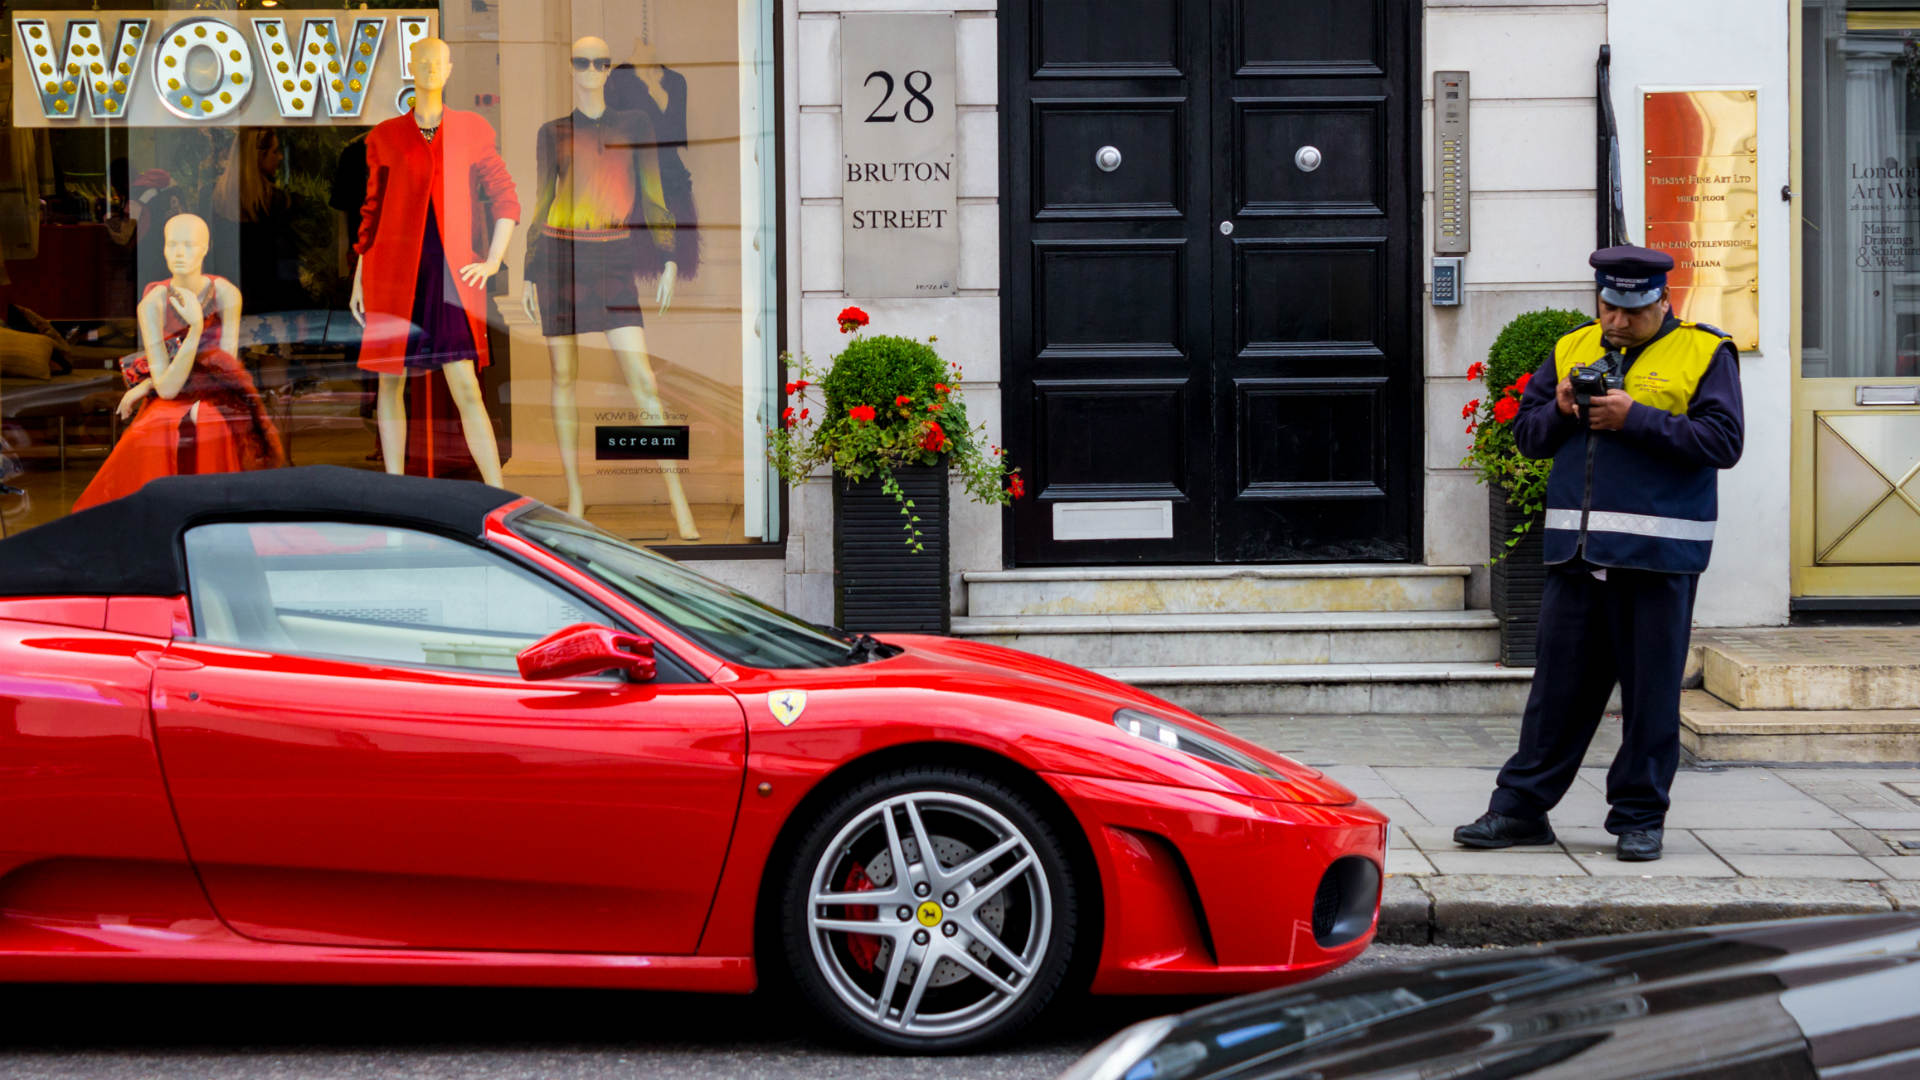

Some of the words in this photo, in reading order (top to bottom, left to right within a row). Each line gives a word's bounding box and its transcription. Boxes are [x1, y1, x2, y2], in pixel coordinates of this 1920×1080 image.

[863, 70, 934, 123] 28
[847, 162, 951, 182] BRUTON
[1852, 183, 1884, 199] Art
[852, 210, 947, 229] STREET
[1864, 223, 1901, 234] Master
[1864, 235, 1914, 247] Drawings
[1681, 259, 1721, 269] ITALIANA
[1856, 246, 1872, 268] &
[1876, 256, 1904, 267] Week
[608, 436, 676, 447] scream
